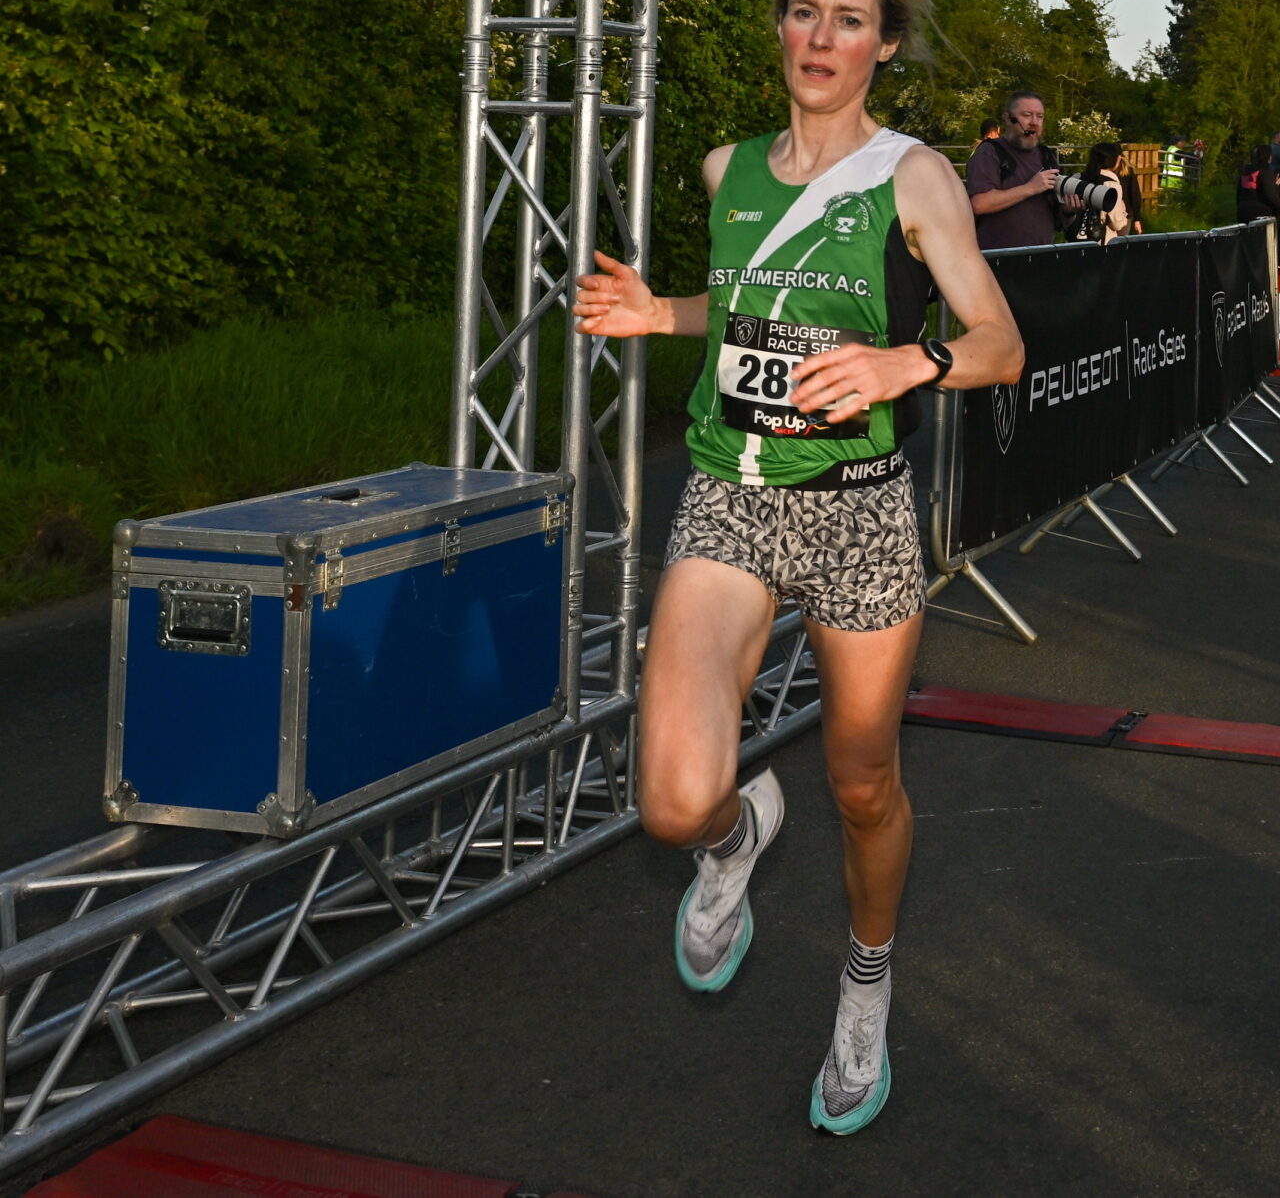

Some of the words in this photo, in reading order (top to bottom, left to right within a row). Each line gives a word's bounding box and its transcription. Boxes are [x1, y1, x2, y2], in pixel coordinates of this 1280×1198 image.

[708, 268, 737, 286] EST
[739, 268, 831, 290] LIMERICK
[834, 274, 872, 297] A.C.
[768, 322, 841, 342] PEUGEOT
[767, 337, 807, 354] RACE
[736, 353, 804, 400] 28
[1029, 345, 1122, 413] PEUGEOT
[1132, 336, 1157, 378] Race
[753, 409, 783, 431] Pop
[784, 413, 808, 433] Up
[841, 458, 888, 482] NIKE
